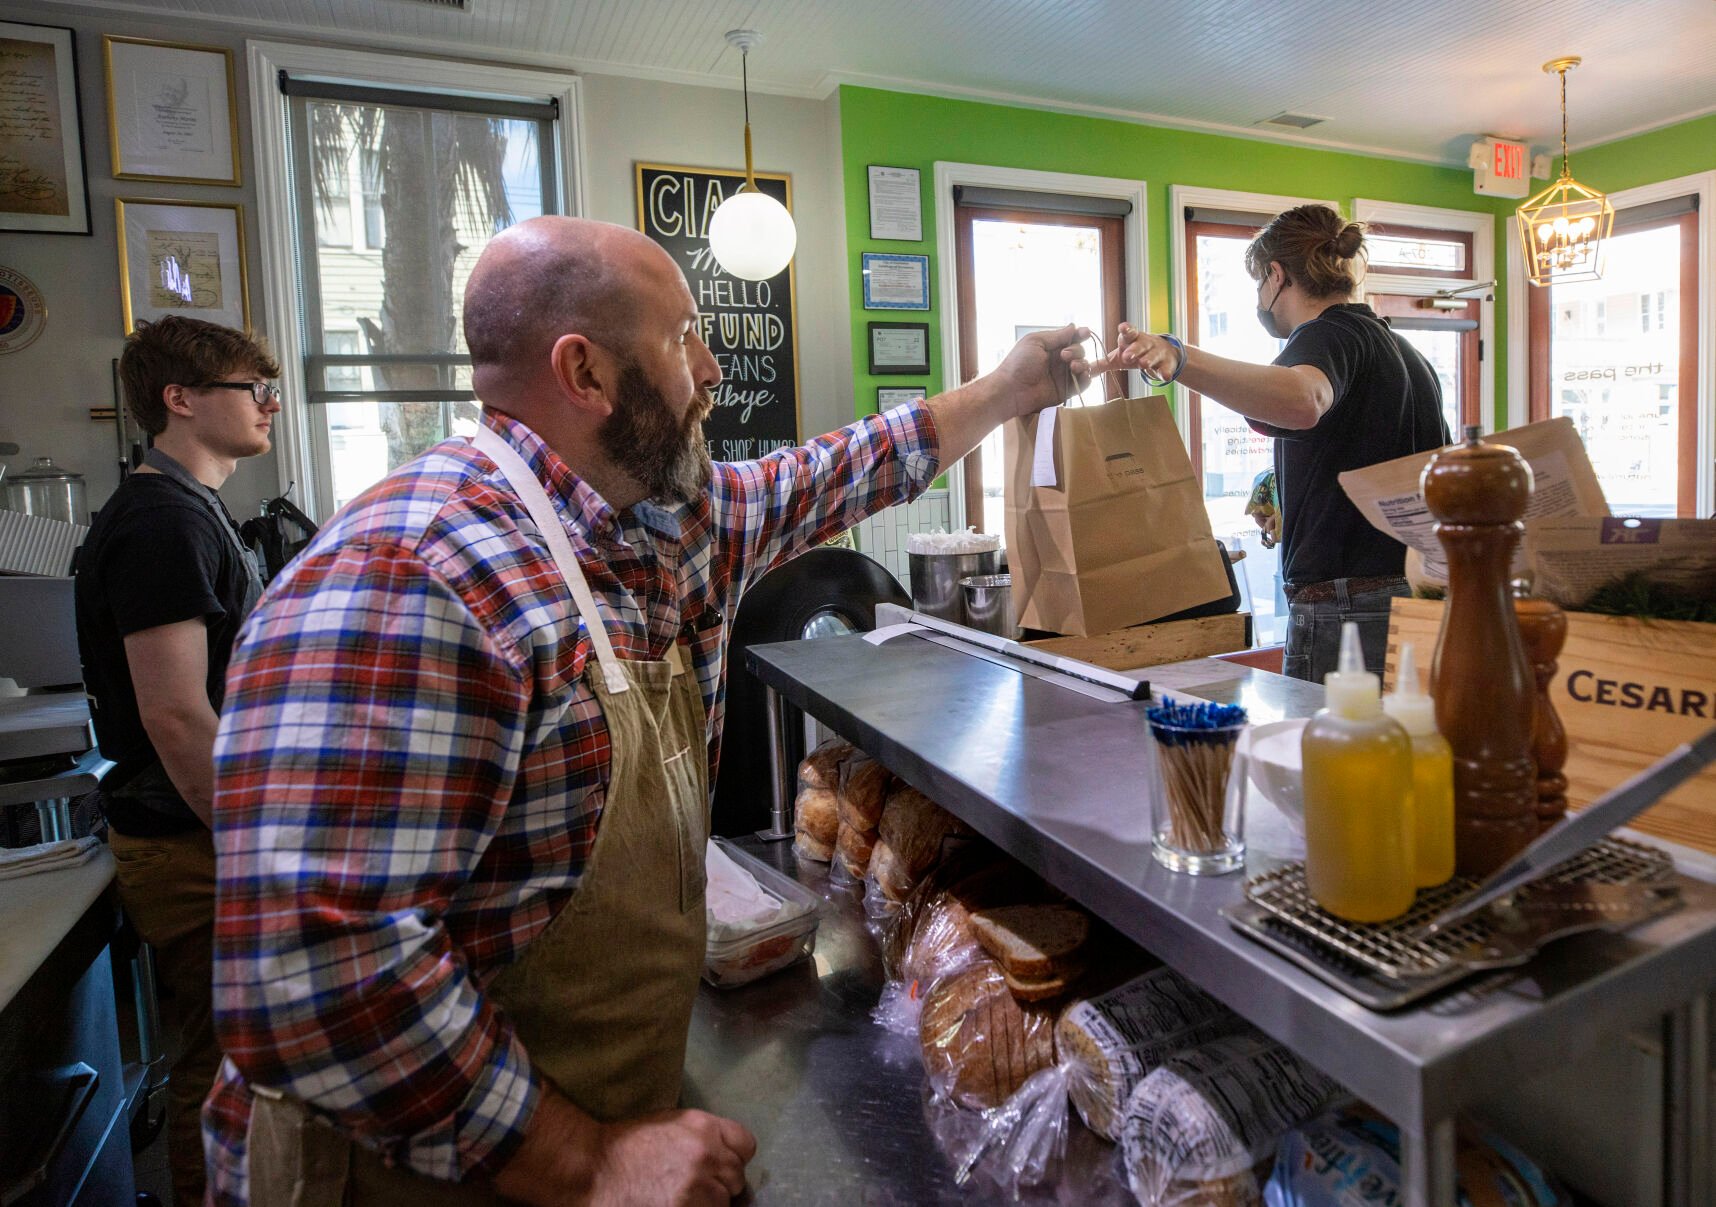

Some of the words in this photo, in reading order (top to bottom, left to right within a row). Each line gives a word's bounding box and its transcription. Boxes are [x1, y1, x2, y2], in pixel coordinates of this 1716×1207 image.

[1495, 143, 1523, 179] EXIT
[649, 175, 748, 239] CIA
[699, 280, 779, 307] HELLO.
[715, 354, 776, 383] EANS
[711, 384, 779, 424] dbye.
[722, 440, 753, 462] SHOP
